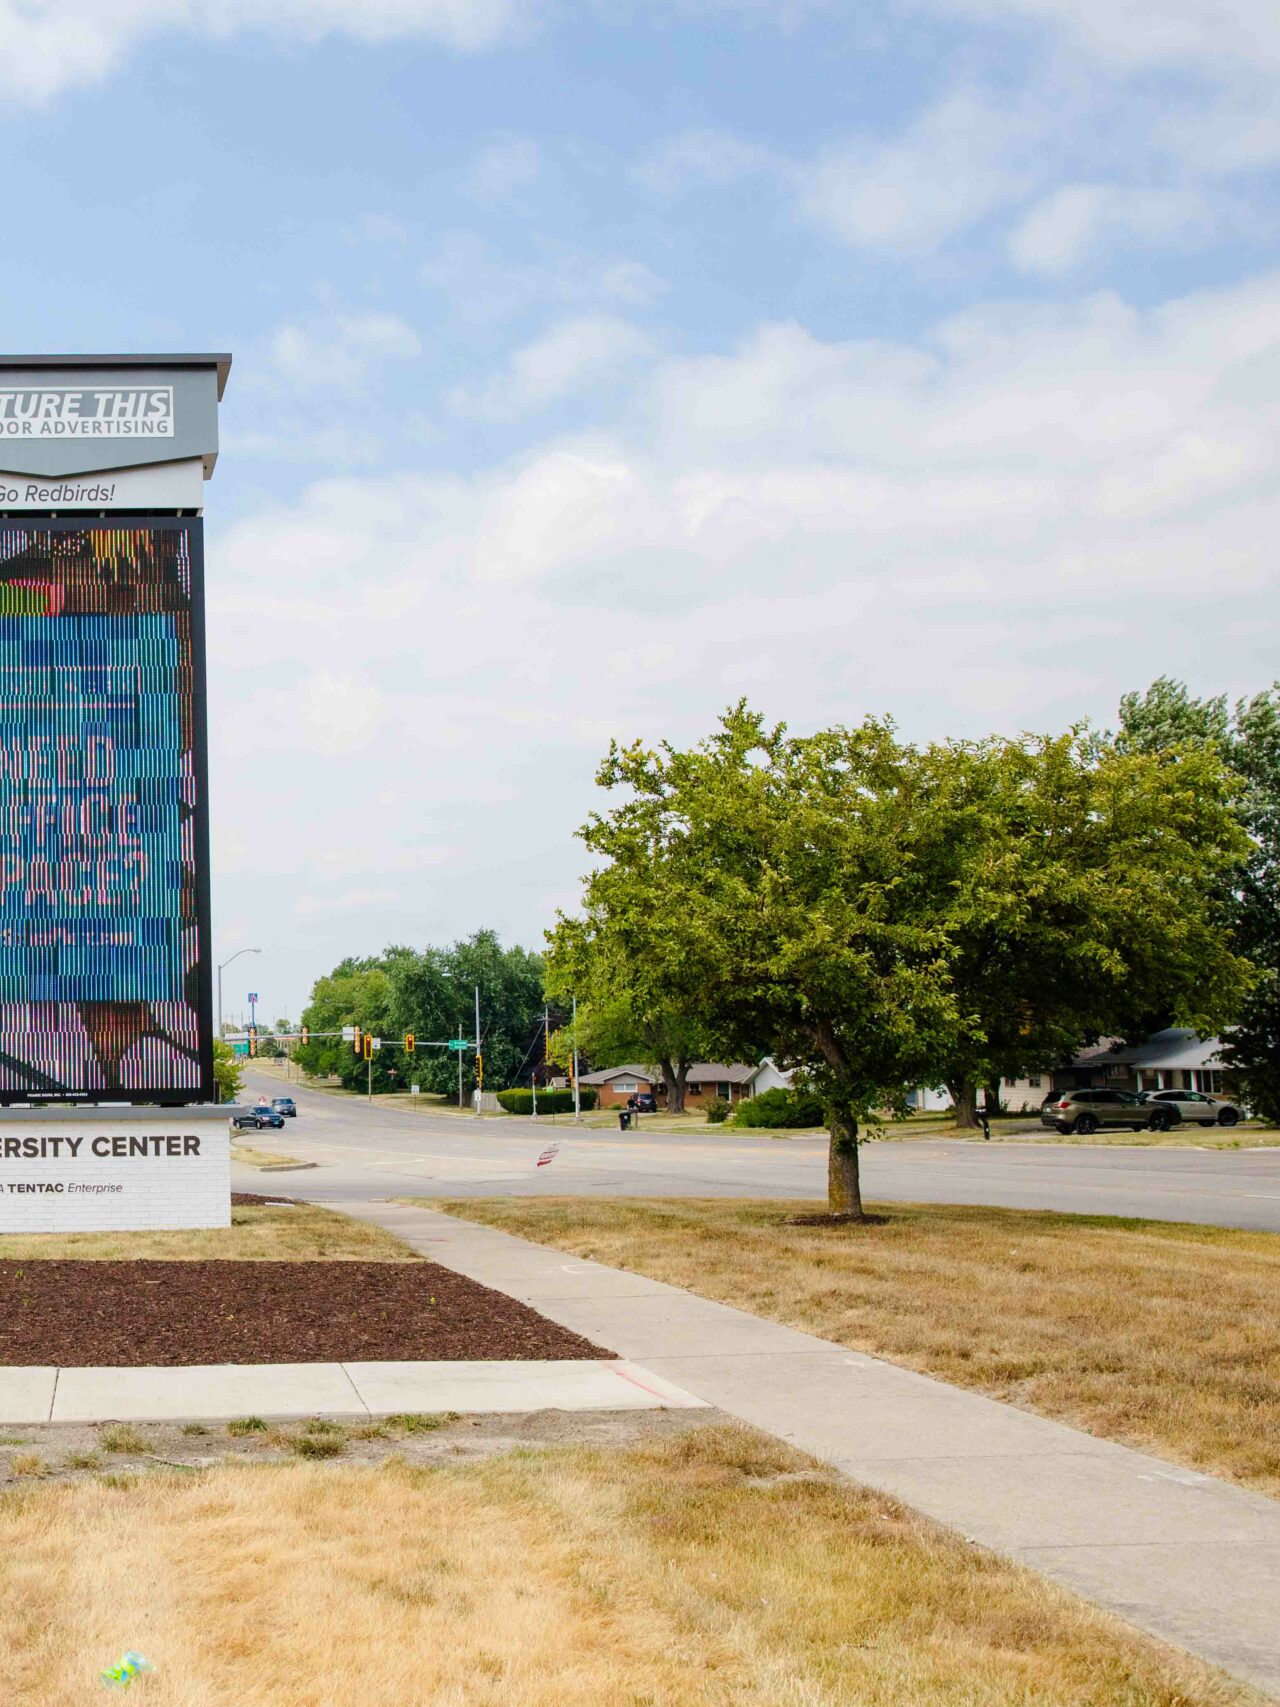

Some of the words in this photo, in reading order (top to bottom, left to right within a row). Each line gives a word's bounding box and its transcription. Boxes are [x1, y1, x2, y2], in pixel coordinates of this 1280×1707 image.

[94, 392, 169, 418] THIS
[40, 420, 168, 434] ADVERTISING
[25, 484, 115, 502] Redbirds!
[92, 1135, 201, 1157] CENTER
[7, 1183, 64, 1193] TENTAC
[68, 1183, 123, 1195] Enterprise
